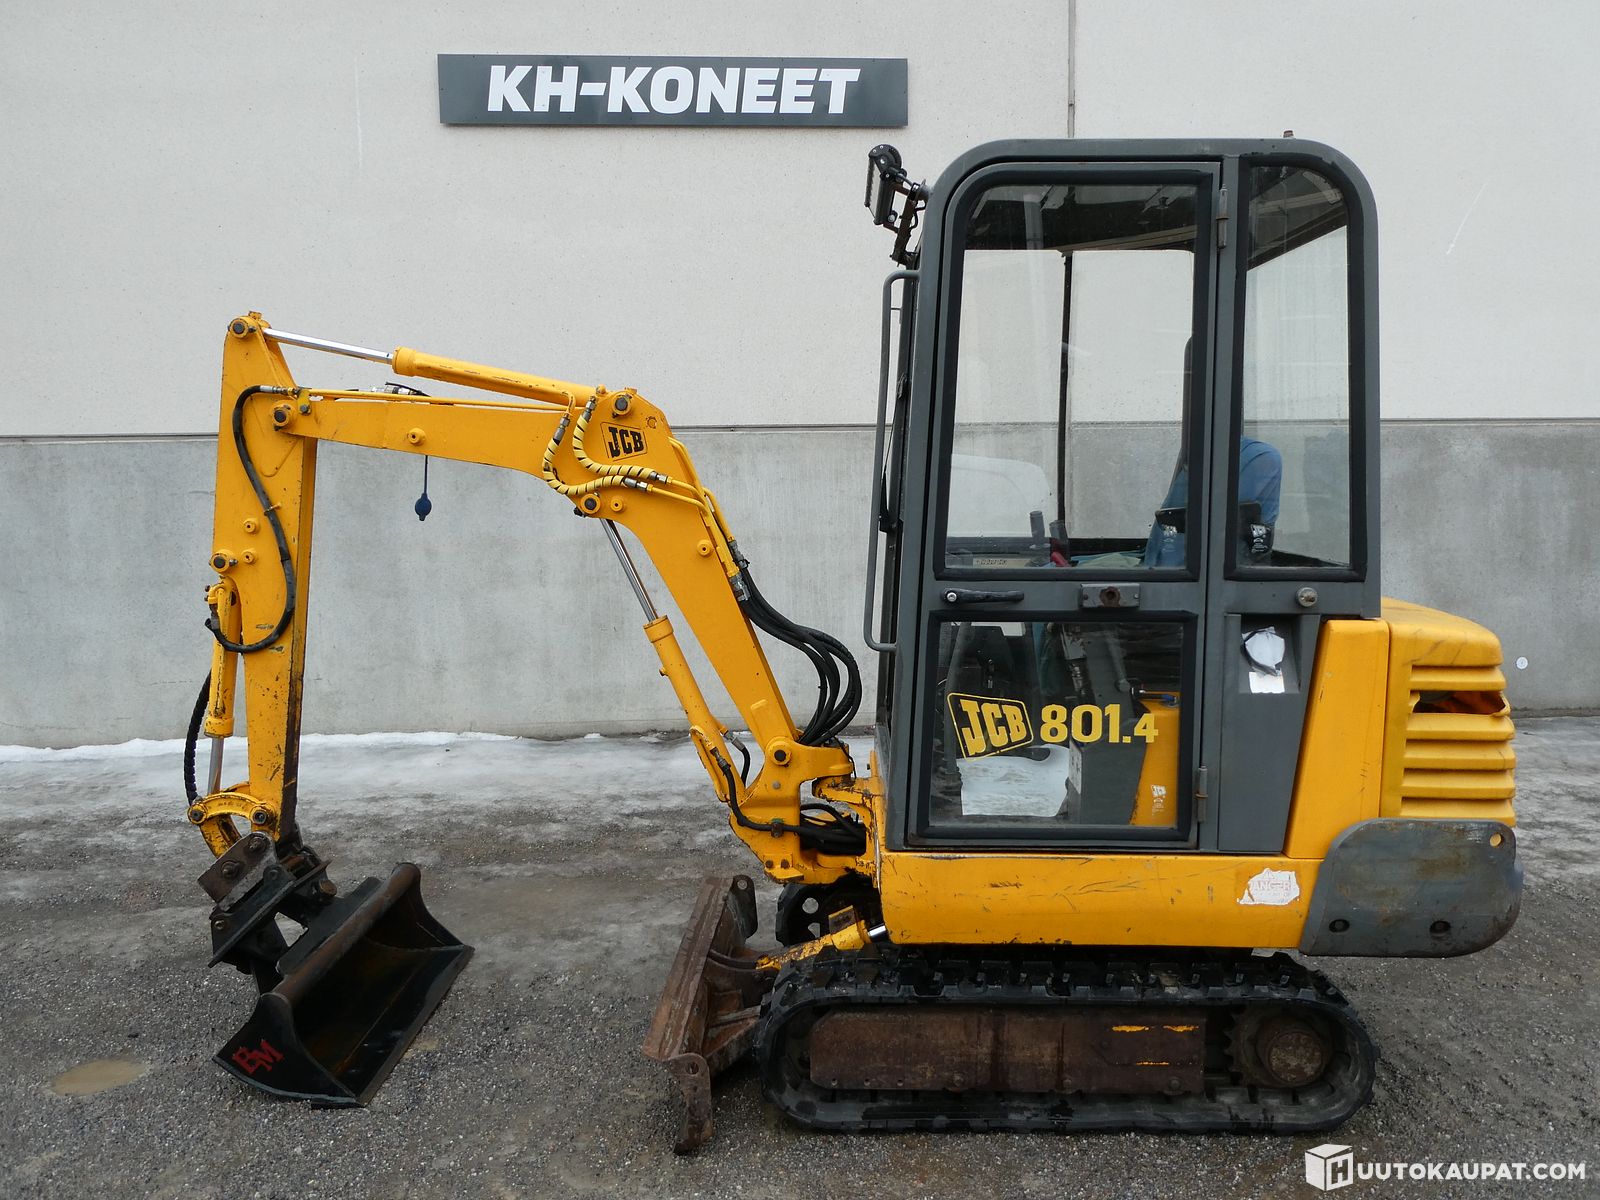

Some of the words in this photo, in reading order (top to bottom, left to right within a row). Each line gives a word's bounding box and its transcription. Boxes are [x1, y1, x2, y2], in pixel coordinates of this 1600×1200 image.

[487, 65, 861, 114] KH-KONEET
[608, 426, 645, 458] JCB
[959, 699, 1027, 756] JCB
[1040, 703, 1159, 744] 801.4
